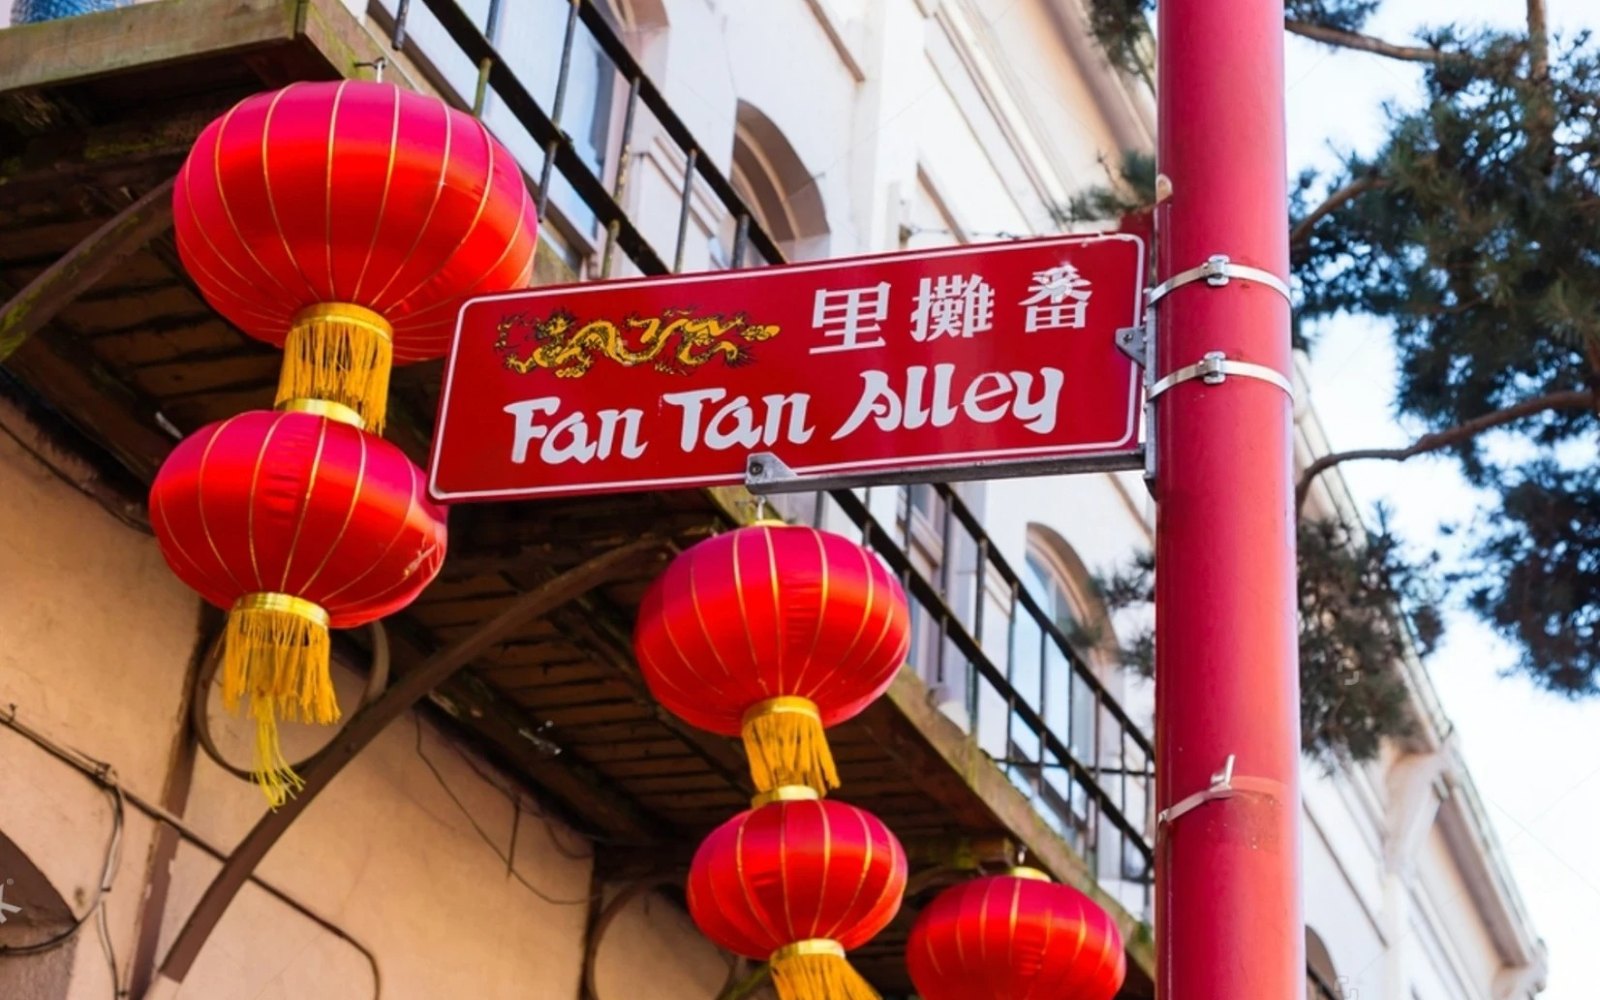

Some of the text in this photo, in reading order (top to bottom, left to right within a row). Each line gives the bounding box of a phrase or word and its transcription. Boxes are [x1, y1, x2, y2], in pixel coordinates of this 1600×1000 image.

[503, 363, 1064, 464] Fan Tan Alley
